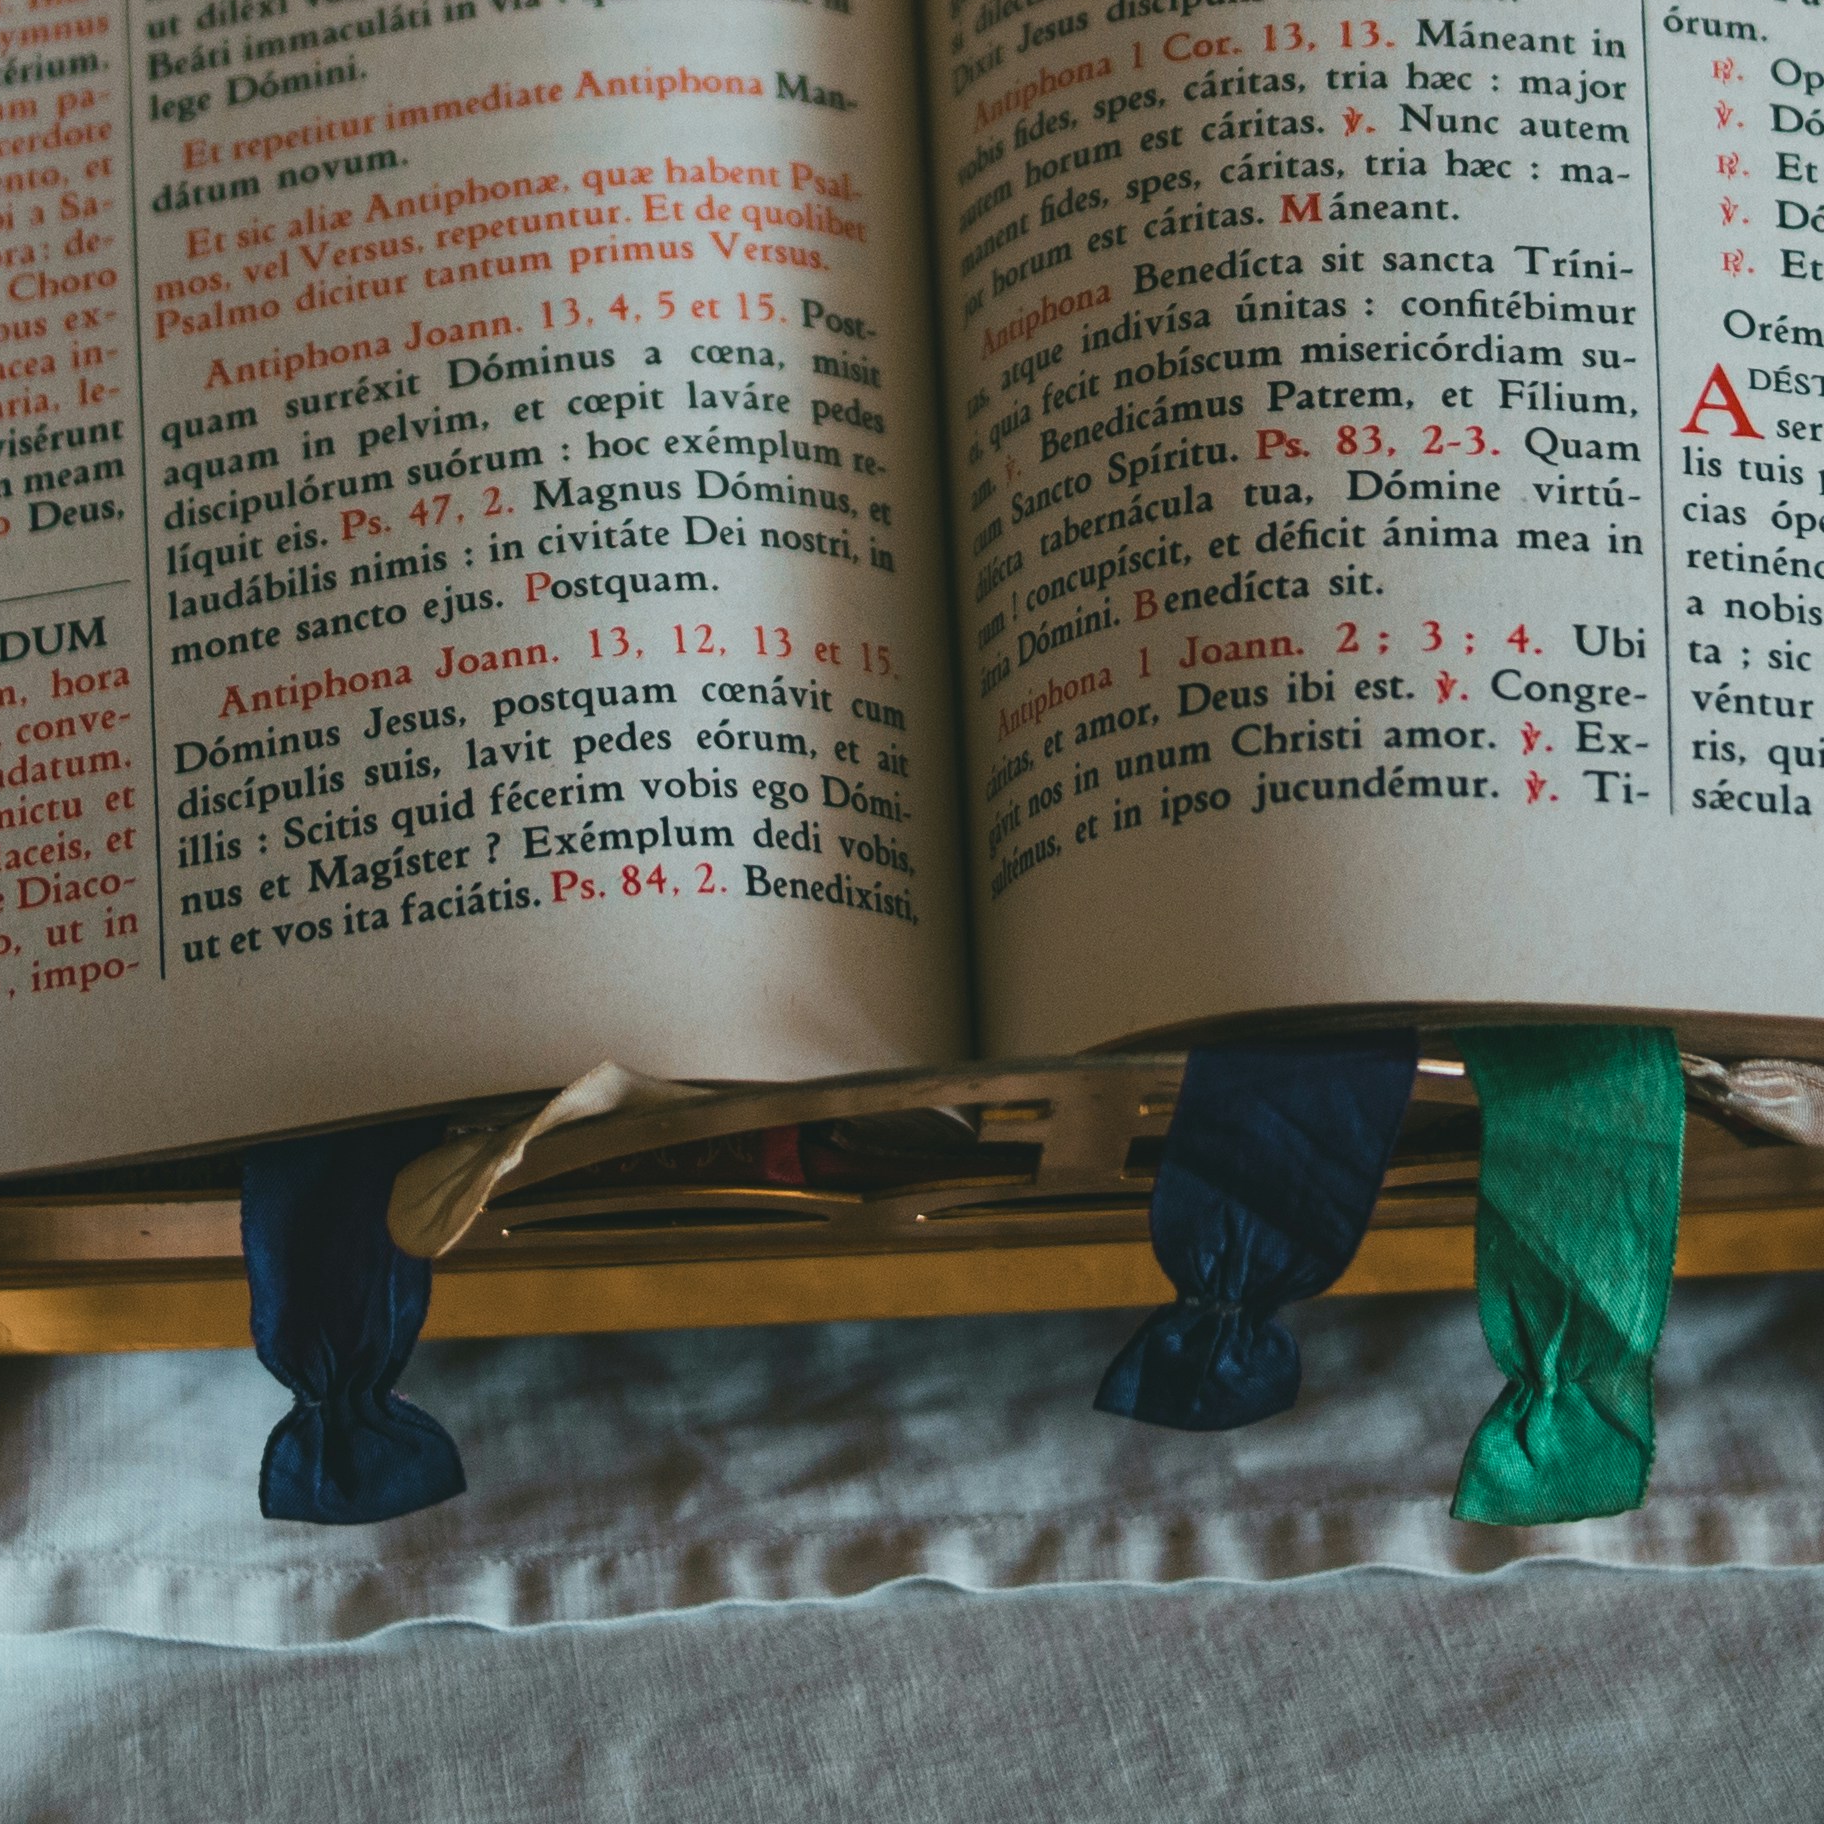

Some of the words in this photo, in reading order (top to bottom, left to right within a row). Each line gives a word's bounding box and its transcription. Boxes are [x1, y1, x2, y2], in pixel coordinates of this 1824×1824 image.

[183, 139, 221, 172] Et
[232, 115, 376, 162] repetitur
[385, 83, 564, 132] immediate
[574, 66, 764, 102] Antiphona
[776, 70, 859, 114] Man-
[1776, 151, 1818, 184] Et
[1133, 247, 1304, 296] Benedícta
[1321, 242, 1365, 274] sit
[1382, 251, 1495, 274] sancta
[1513, 244, 1634, 281] Tríni-
[1781, 248, 1824, 282] Et
[160, 407, 258, 451] quam
[285, 368, 421, 420] surréxit
[447, 344, 616, 390] Dóminus
[644, 346, 663, 366] a
[690, 345, 786, 371] cœna,
[811, 349, 883, 390] misit
[1011, 472, 1093, 526] Sancto
[1108, 442, 1239, 488] Spíritu.
[1255, 428, 1311, 461] Ps.
[1336, 424, 1397, 458] 83,
[1423, 424, 1501, 456] 2-3.
[1524, 426, 1641, 467] Quam
[1683, 445, 1723, 478] lis
[1738, 454, 1804, 486] tuis
[1040, 483, 1215, 557] tabernácula
[1243, 483, 1314, 508] tua,
[1346, 468, 1501, 502] Dómine
[1533, 473, 1641, 508] virtú-
[1682, 492, 1747, 526] cias
[1133, 569, 1310, 622] Benedícta
[1328, 563, 1384, 597] sit.
[1686, 595, 1705, 616] a
[1725, 592, 1823, 627] nobis
[171, 626, 281, 666] monte
[295, 604, 408, 643] sancto
[423, 585, 504, 625] ejus.
[525, 571, 719, 604] Postquam.
[1691, 681, 1814, 720] véntur
[177, 762, 345, 821] discípulis
[364, 747, 441, 787] suis,
[466, 729, 552, 771] lavit
[572, 720, 672, 765] pedes
[696, 718, 818, 760] eórum,
[833, 740, 861, 766] et
[877, 743, 910, 779] ait
[1692, 778, 1812, 817] sǽcula
[16, 871, 136, 911] Diaco-
[182, 935, 221, 964] ut
[229, 927, 262, 955] et
[271, 917, 334, 947] vos
[343, 902, 390, 936] ita
[400, 877, 541, 927] faciátis.
[551, 869, 606, 903] Ps.
[621, 864, 680, 897] 84,
[698, 862, 727, 894] 2.
[744, 864, 919, 927] Benedixísti,
[31, 958, 140, 994] impo-
